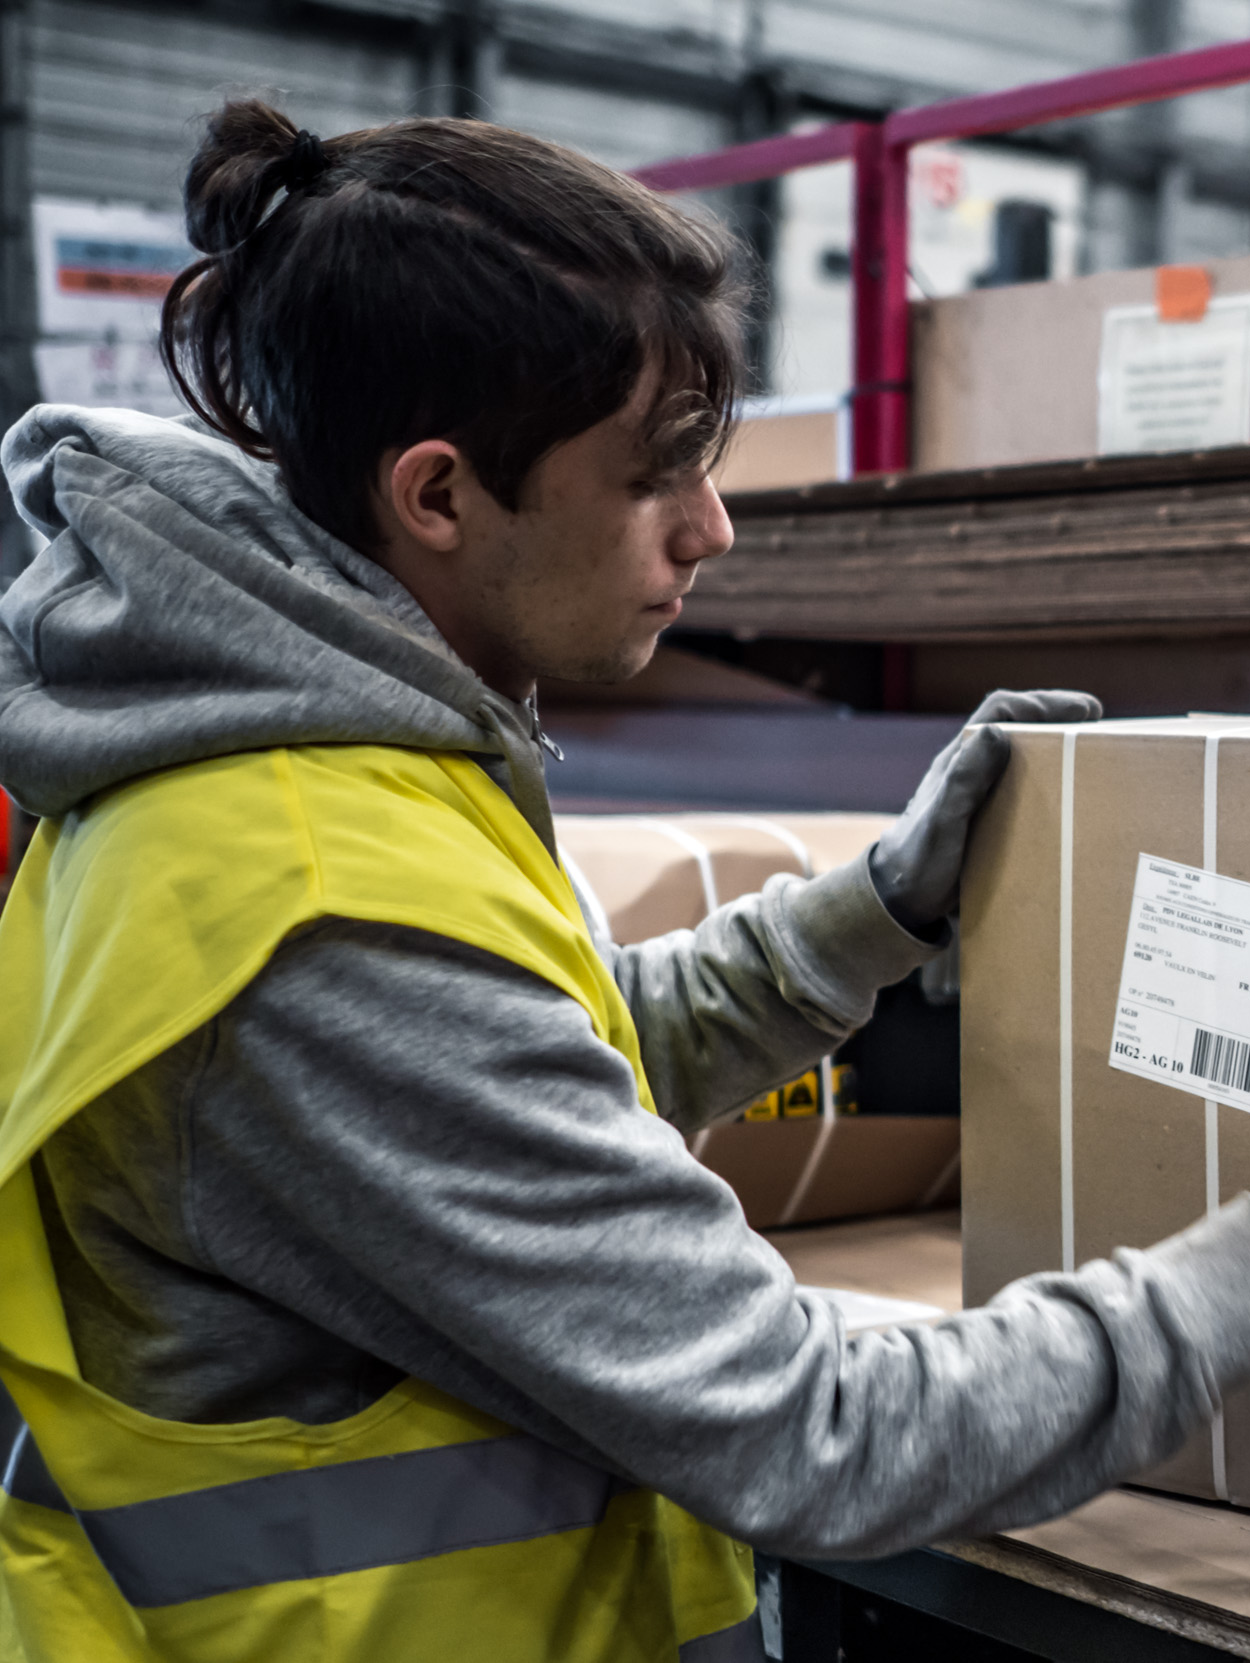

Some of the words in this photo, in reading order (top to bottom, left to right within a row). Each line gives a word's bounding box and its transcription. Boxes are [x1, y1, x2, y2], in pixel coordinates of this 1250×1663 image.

[1176, 911, 1213, 927] LEGALLAIS
[1214, 922, 1223, 930] DE
[1224, 925, 1243, 935] LYON
[1176, 923, 1208, 936] FRANKLIN
[1209, 932, 1247, 948] ROOSEVELT
[1197, 970, 1215, 981] VELIN
[1239, 982, 1249, 991] FR
[1115, 1041, 1140, 1059] HG2
[1152, 1054, 1167, 1068] AG
[1171, 1060, 1184, 1073] 10
